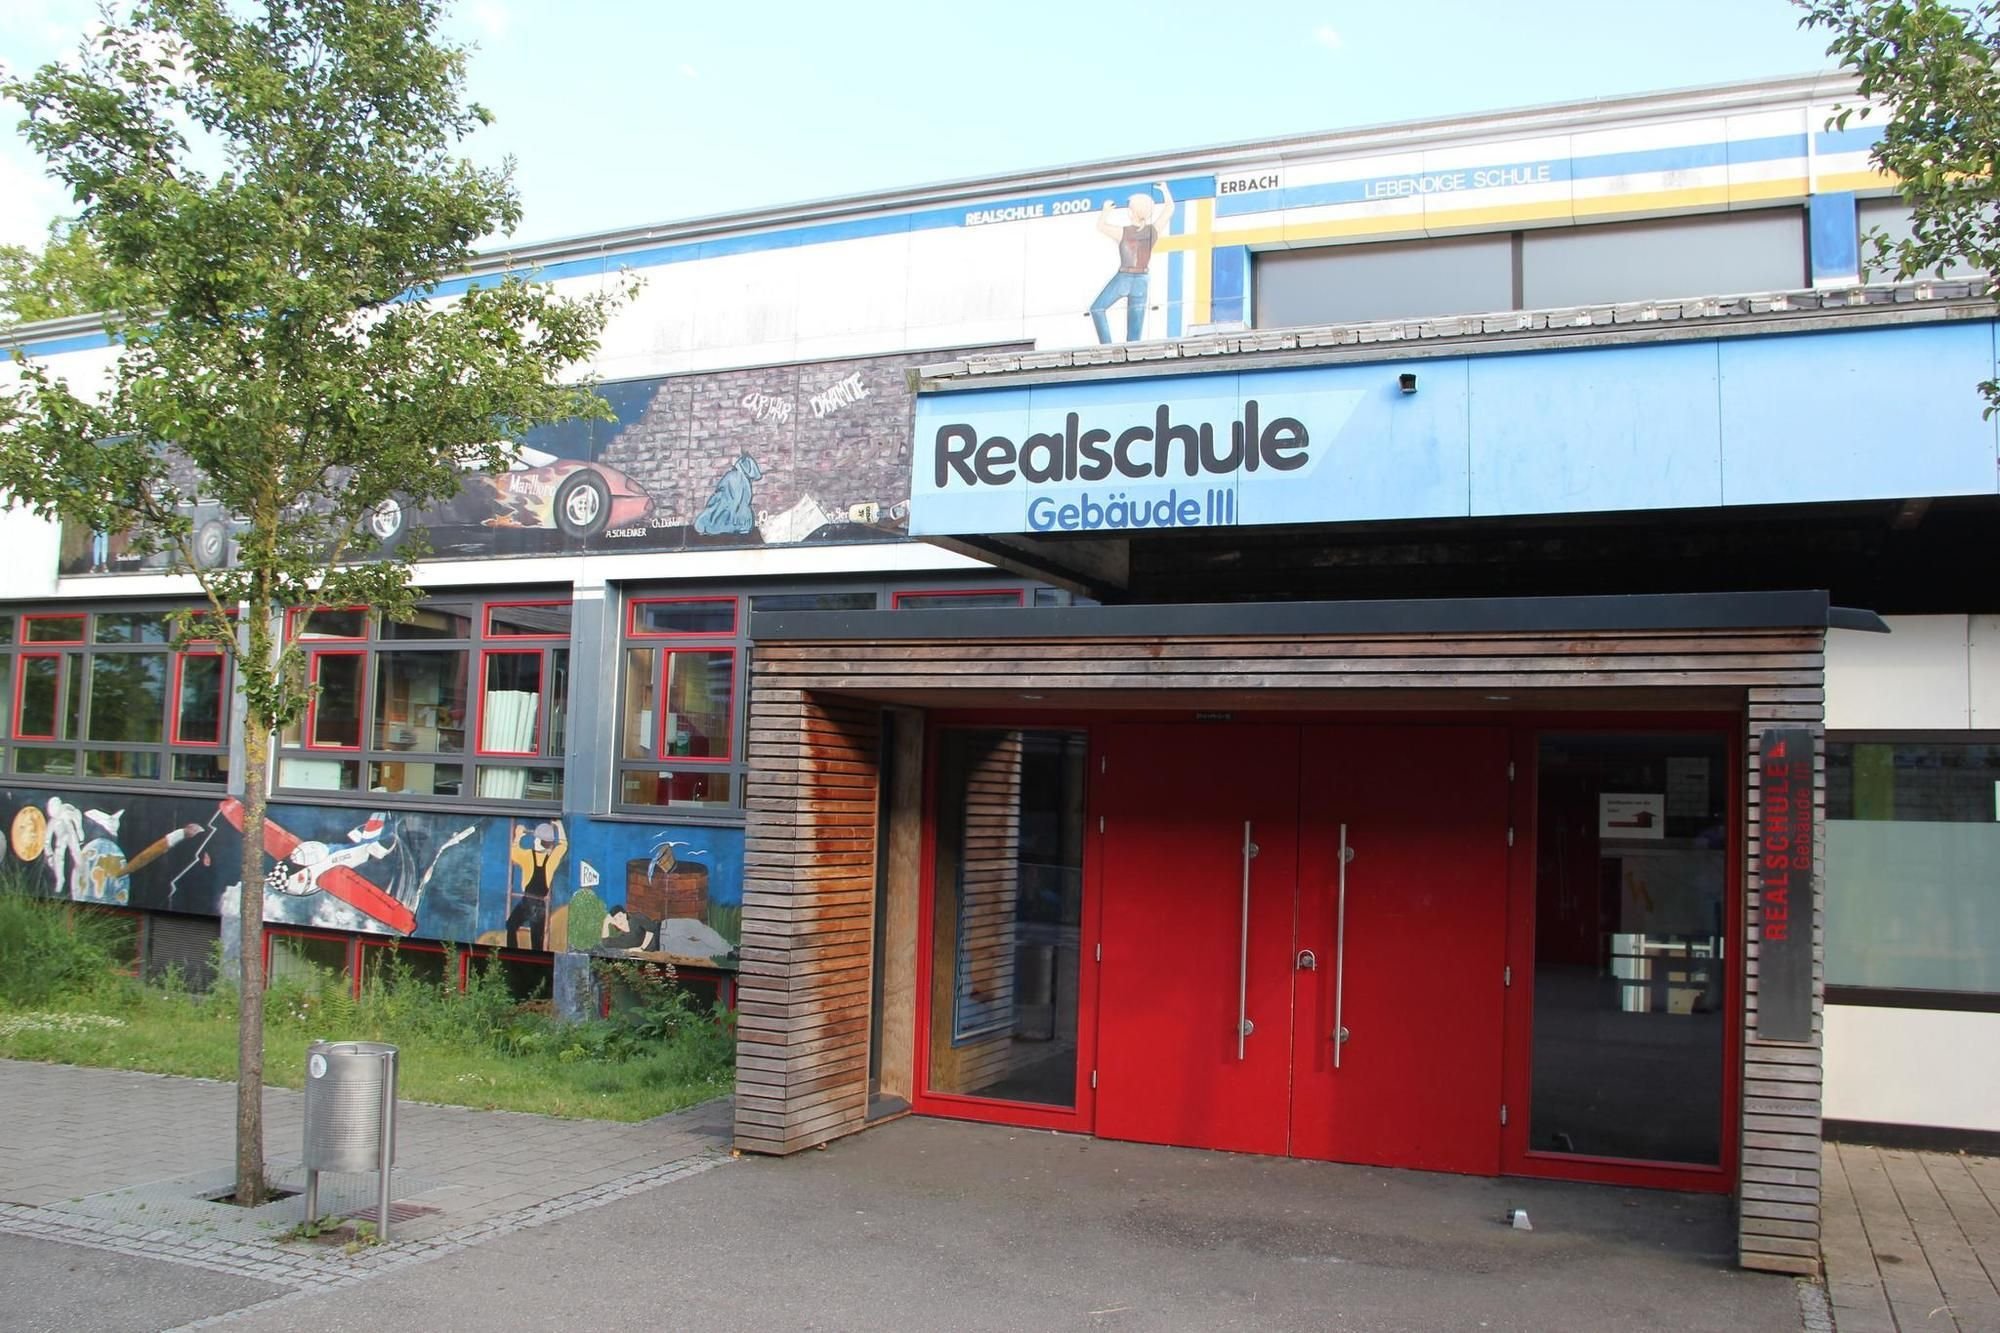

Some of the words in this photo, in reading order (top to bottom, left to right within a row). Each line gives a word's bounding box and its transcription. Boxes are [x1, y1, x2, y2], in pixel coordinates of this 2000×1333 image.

[1220, 175, 1279, 194] ERBACH
[1364, 173, 1466, 199] LEBENDIGE
[1473, 165, 1551, 188] SCHULE
[965, 203, 1044, 226] REALSCHULE
[1052, 198, 1092, 215] 2000
[934, 399, 1310, 488] Realschule
[1027, 488, 1201, 531] Gebäude
[1206, 488, 1234, 526] III
[1793, 788, 1811, 871] Gebäude
[1766, 764, 1790, 940] REALSCHULE
